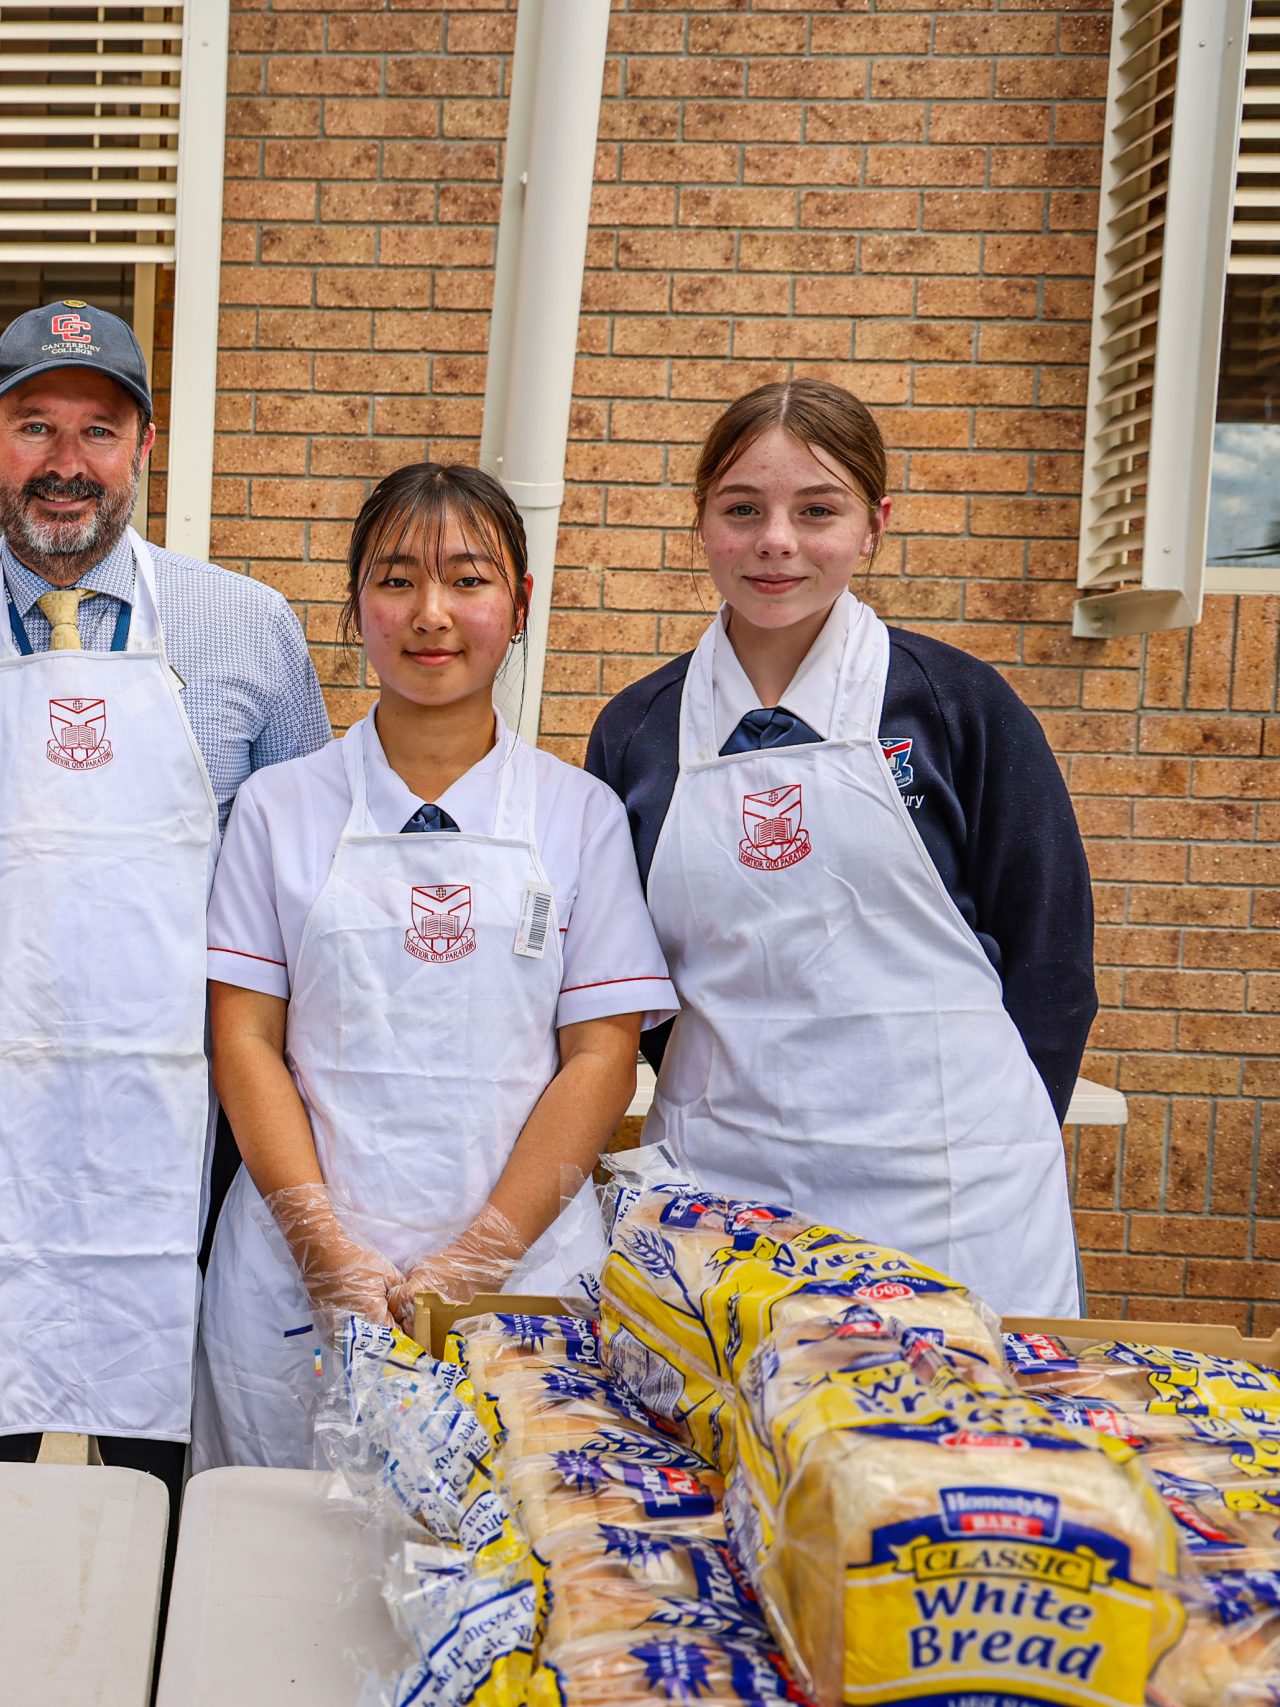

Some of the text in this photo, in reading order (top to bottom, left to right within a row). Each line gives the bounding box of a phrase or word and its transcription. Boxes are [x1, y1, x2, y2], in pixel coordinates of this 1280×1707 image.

[41, 342, 101, 353] CANTERBURY
[51, 348, 93, 356] COLLEGE
[945, 1492, 1055, 1520] Homestyle
[971, 1515, 1030, 1532] BAKE
[924, 1547, 1084, 1580] CLASSIC
[913, 1580, 1093, 1631] White
[909, 1624, 1104, 1681] Bread
